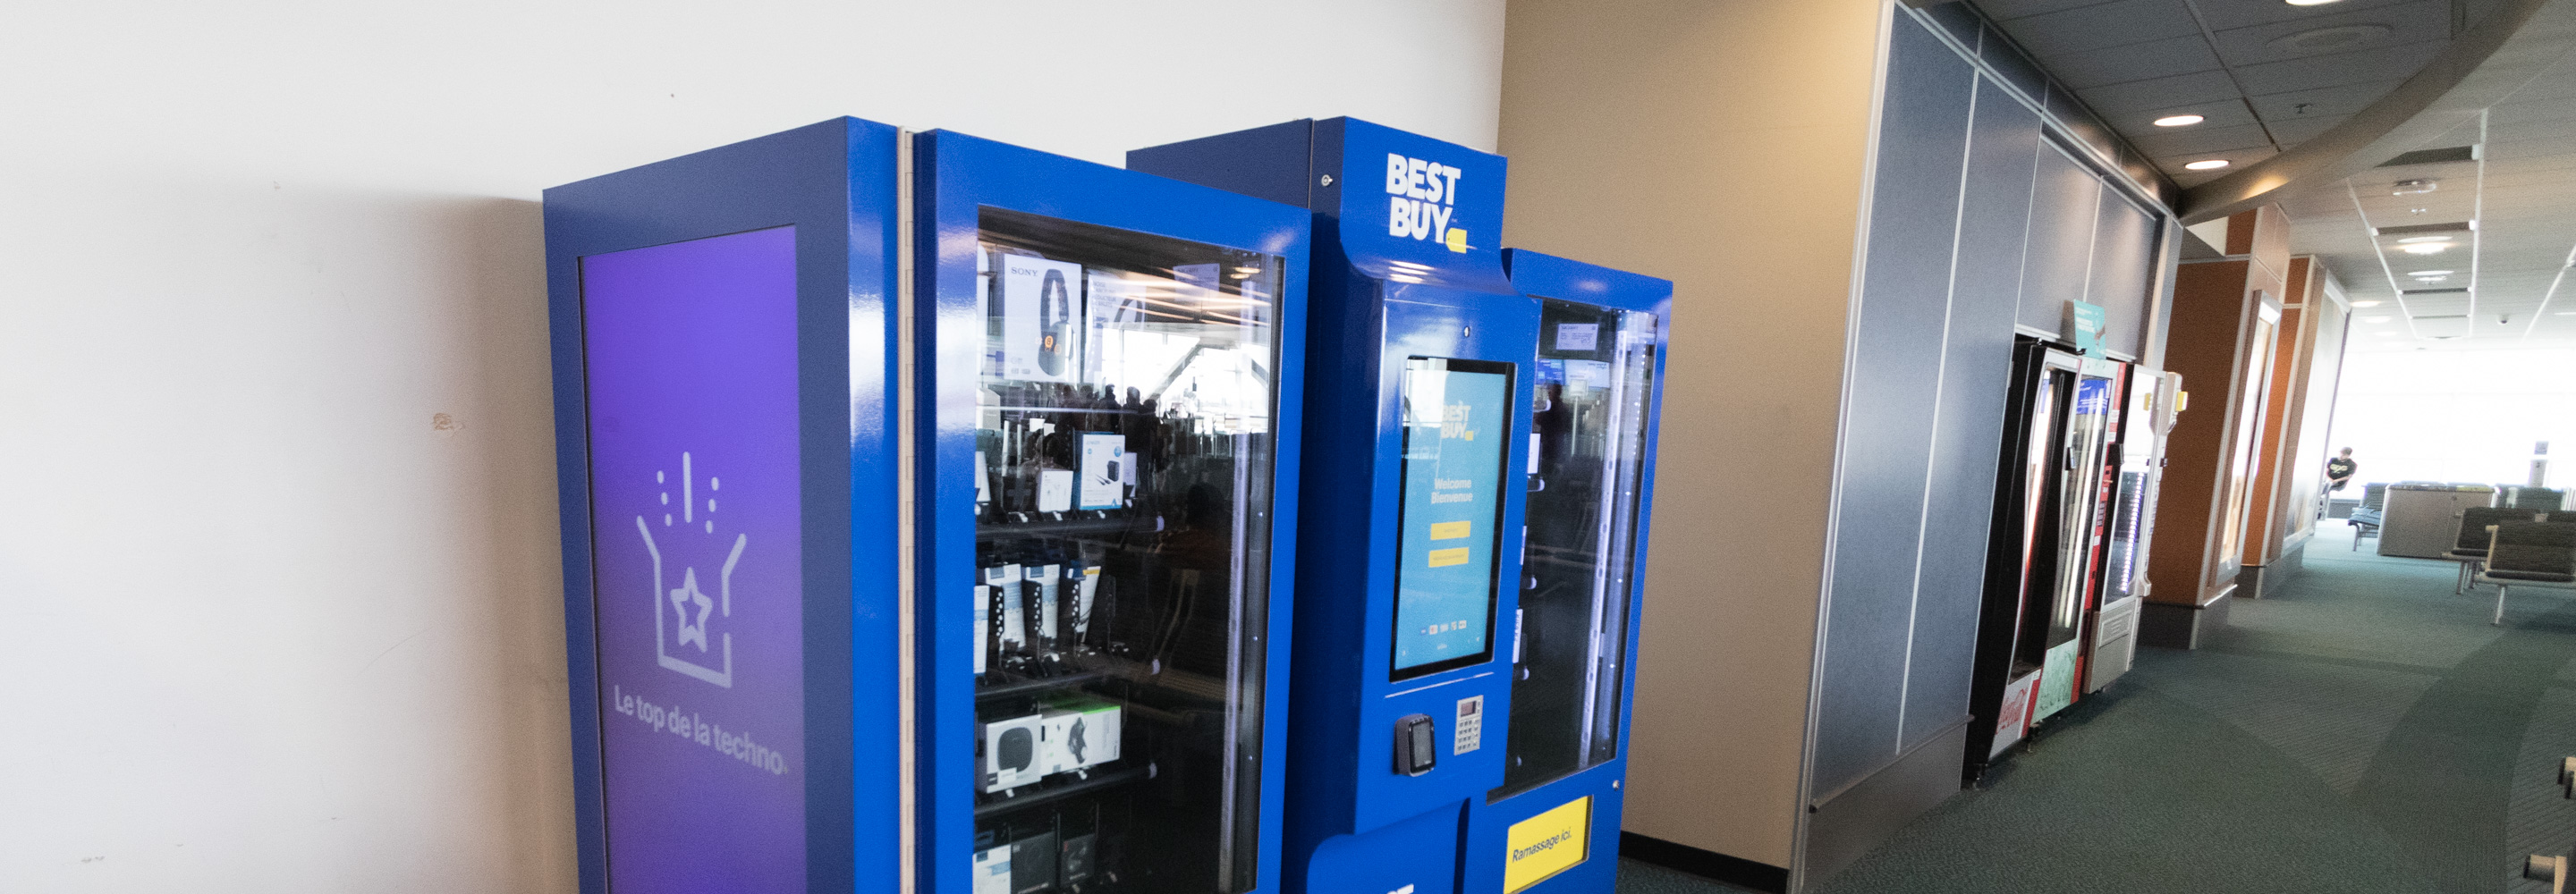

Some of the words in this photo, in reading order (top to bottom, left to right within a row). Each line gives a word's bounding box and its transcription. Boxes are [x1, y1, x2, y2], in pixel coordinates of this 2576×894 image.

[1386, 152, 1462, 206] BEST
[1389, 196, 1453, 244] BUY
[1011, 266, 1038, 277] SONY
[1443, 404, 1471, 422] BEST
[1441, 422, 1468, 439] BUY
[1434, 477, 1472, 490] Welcome
[1431, 492, 1473, 504] Bienvenue
[614, 685, 634, 716] Le
[636, 696, 665, 732] top
[668, 705, 691, 738] de
[693, 713, 710, 746] la
[1512, 834, 1560, 864] Ramassage
[1561, 826, 1572, 842] ici.
